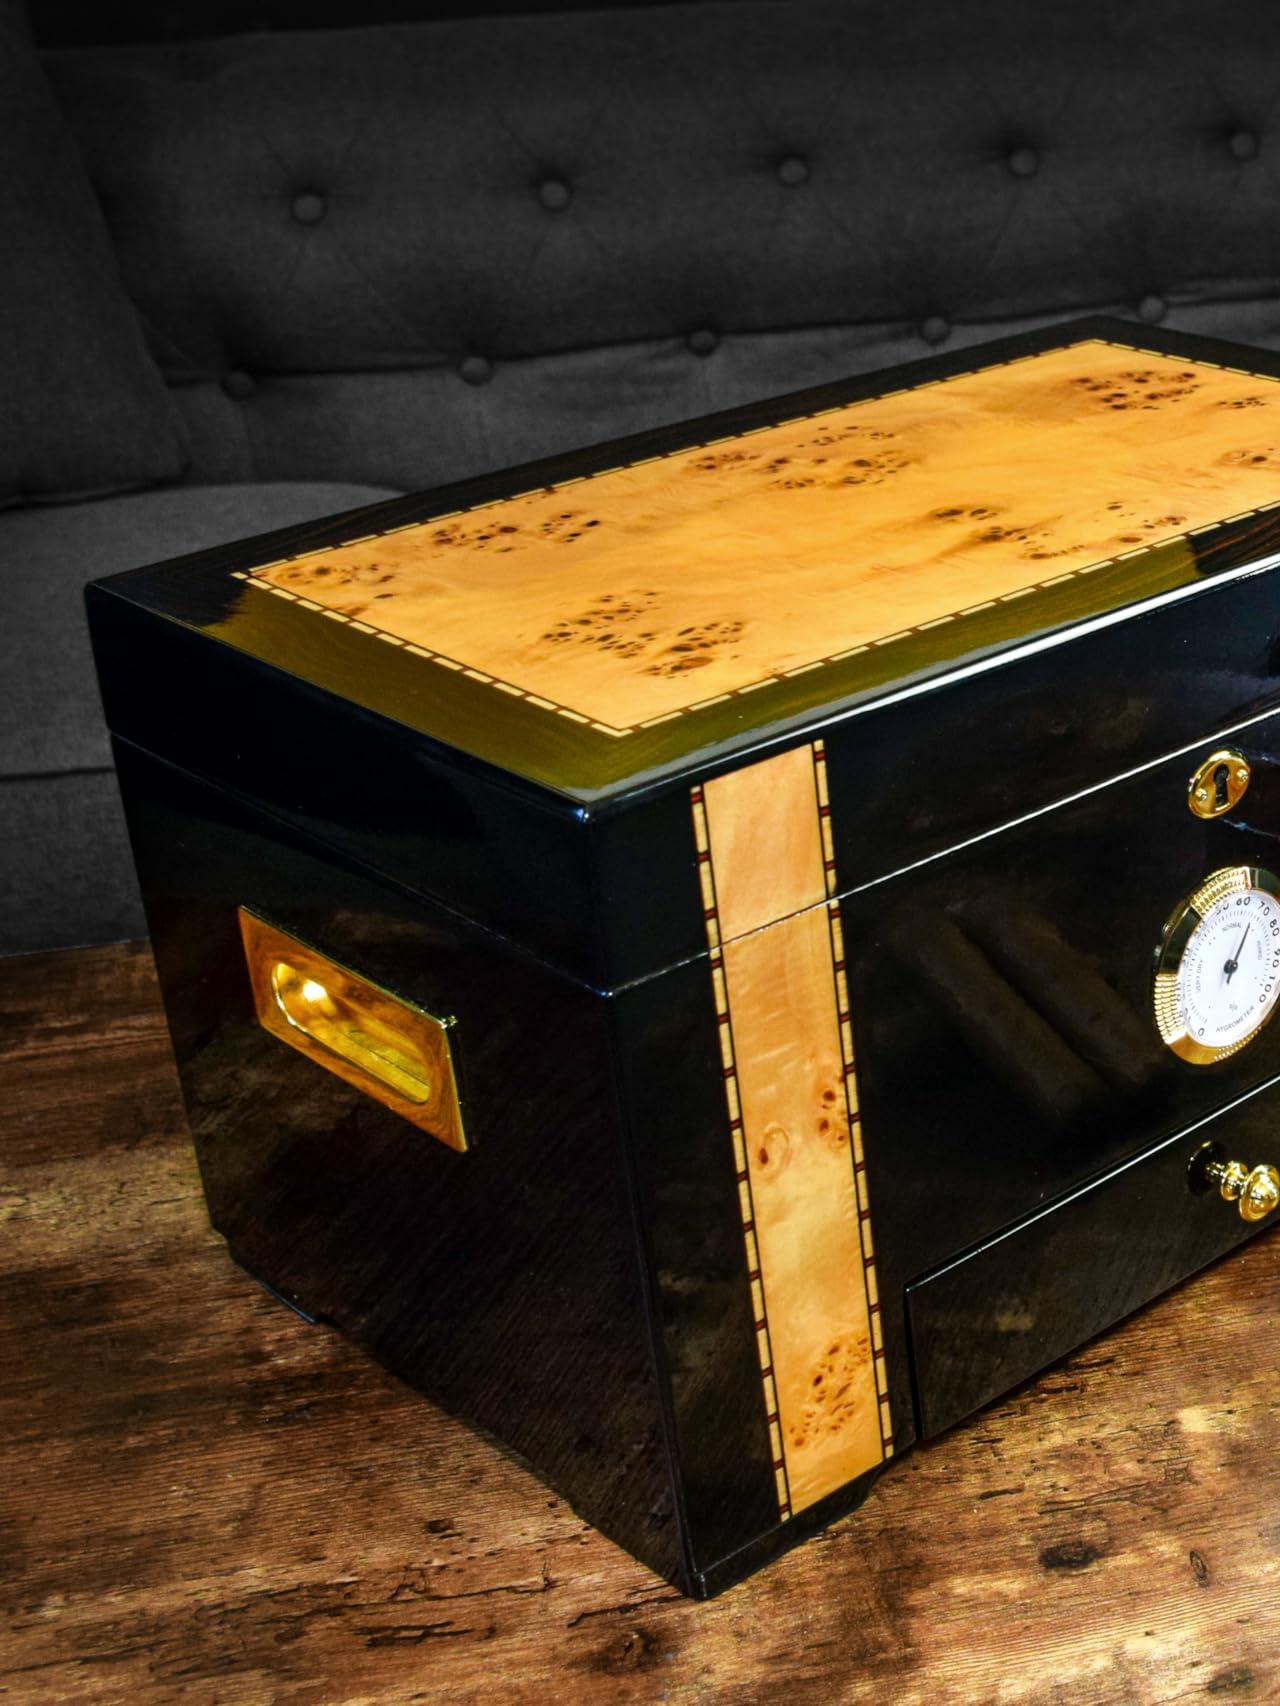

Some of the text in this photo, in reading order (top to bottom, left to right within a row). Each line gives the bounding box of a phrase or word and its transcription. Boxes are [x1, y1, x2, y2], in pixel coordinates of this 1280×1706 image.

[1235, 896, 1251, 906] 60
[1257, 900, 1270, 917] 70
[1269, 918, 1280, 937] 80
[1271, 947, 1280, 968] 90
[1259, 975, 1276, 1003] 100
